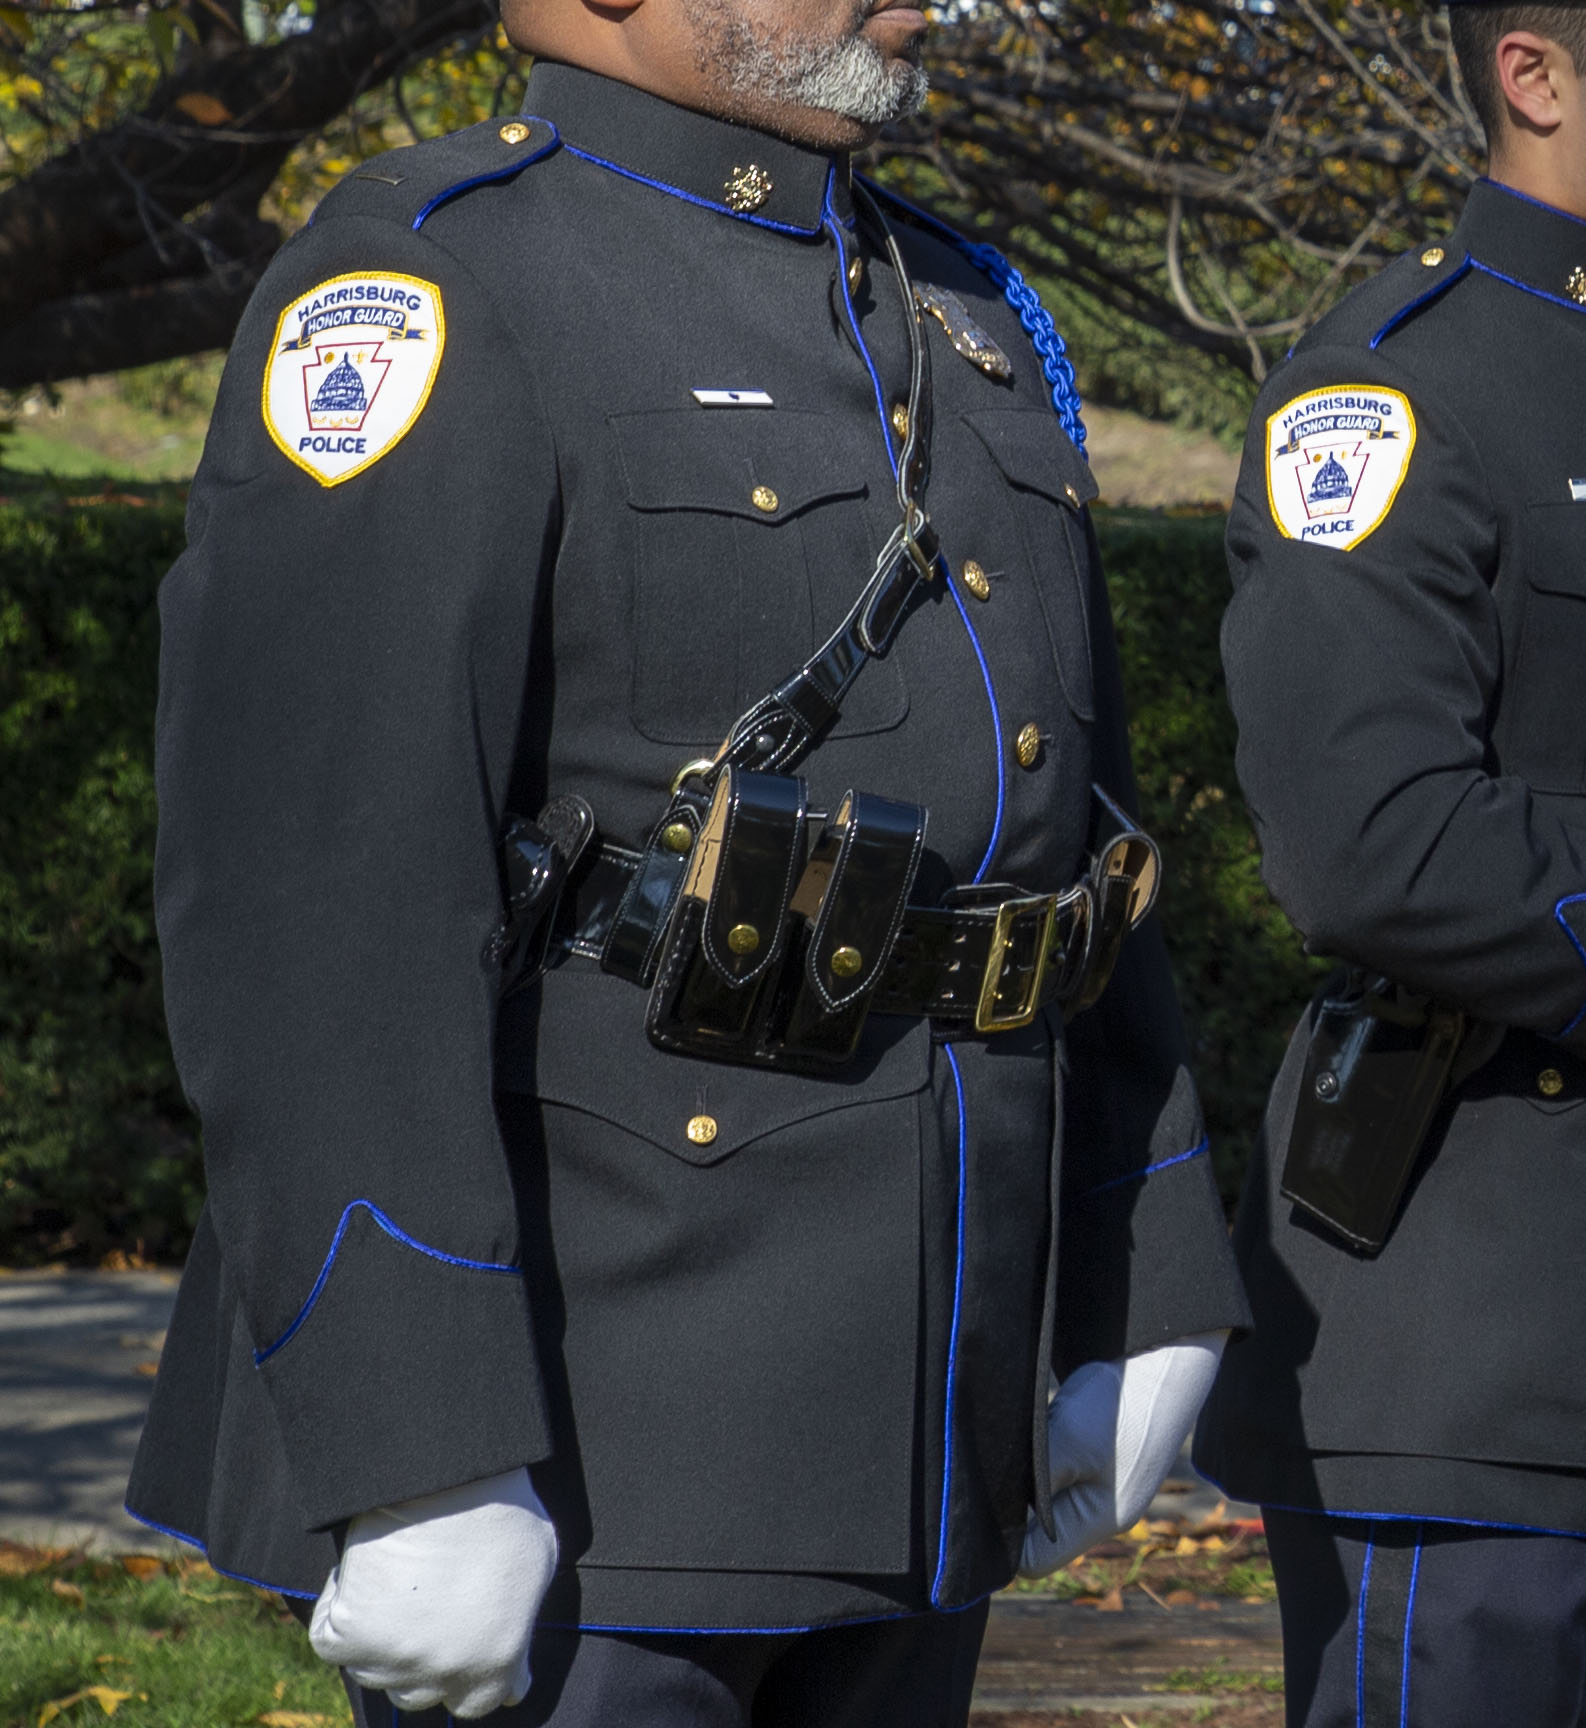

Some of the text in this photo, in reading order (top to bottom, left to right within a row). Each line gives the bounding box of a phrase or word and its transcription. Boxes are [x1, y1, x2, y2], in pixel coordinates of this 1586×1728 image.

[298, 285, 421, 322] HARRISBURG
[307, 308, 403, 333] HONOR GUARD
[1283, 397, 1392, 429] HARRISBURG
[1294, 415, 1380, 439] HONOR GUARD
[299, 436, 366, 454] POLICE
[1301, 519, 1355, 541] POLICE
